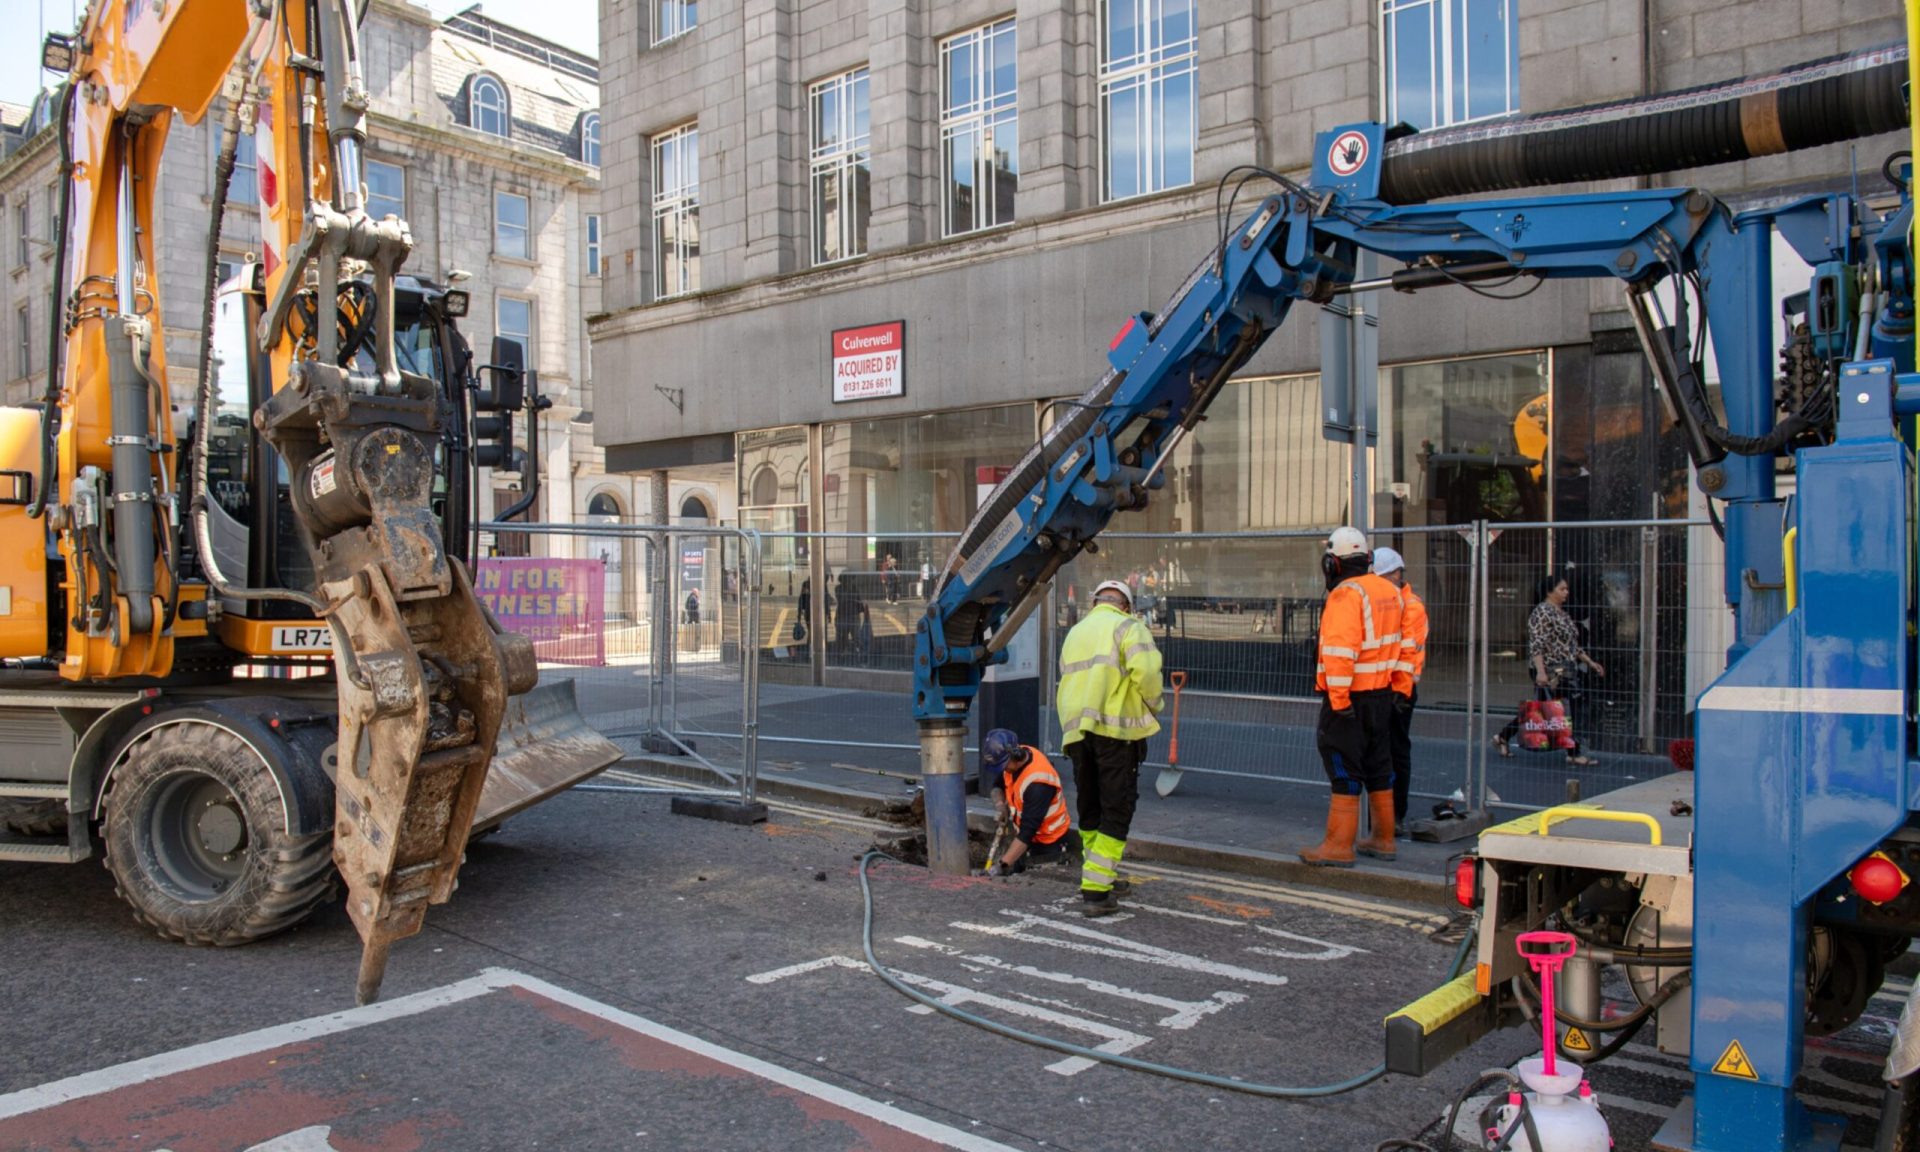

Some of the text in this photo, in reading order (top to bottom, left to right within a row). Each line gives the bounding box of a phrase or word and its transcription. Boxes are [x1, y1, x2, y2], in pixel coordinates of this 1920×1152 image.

[842, 331, 893, 350] Culverwell
[838, 355, 898, 378] ACQUIRED BY
[843, 377, 892, 393] 0131 226 6611
[511, 568, 566, 590] FOR
